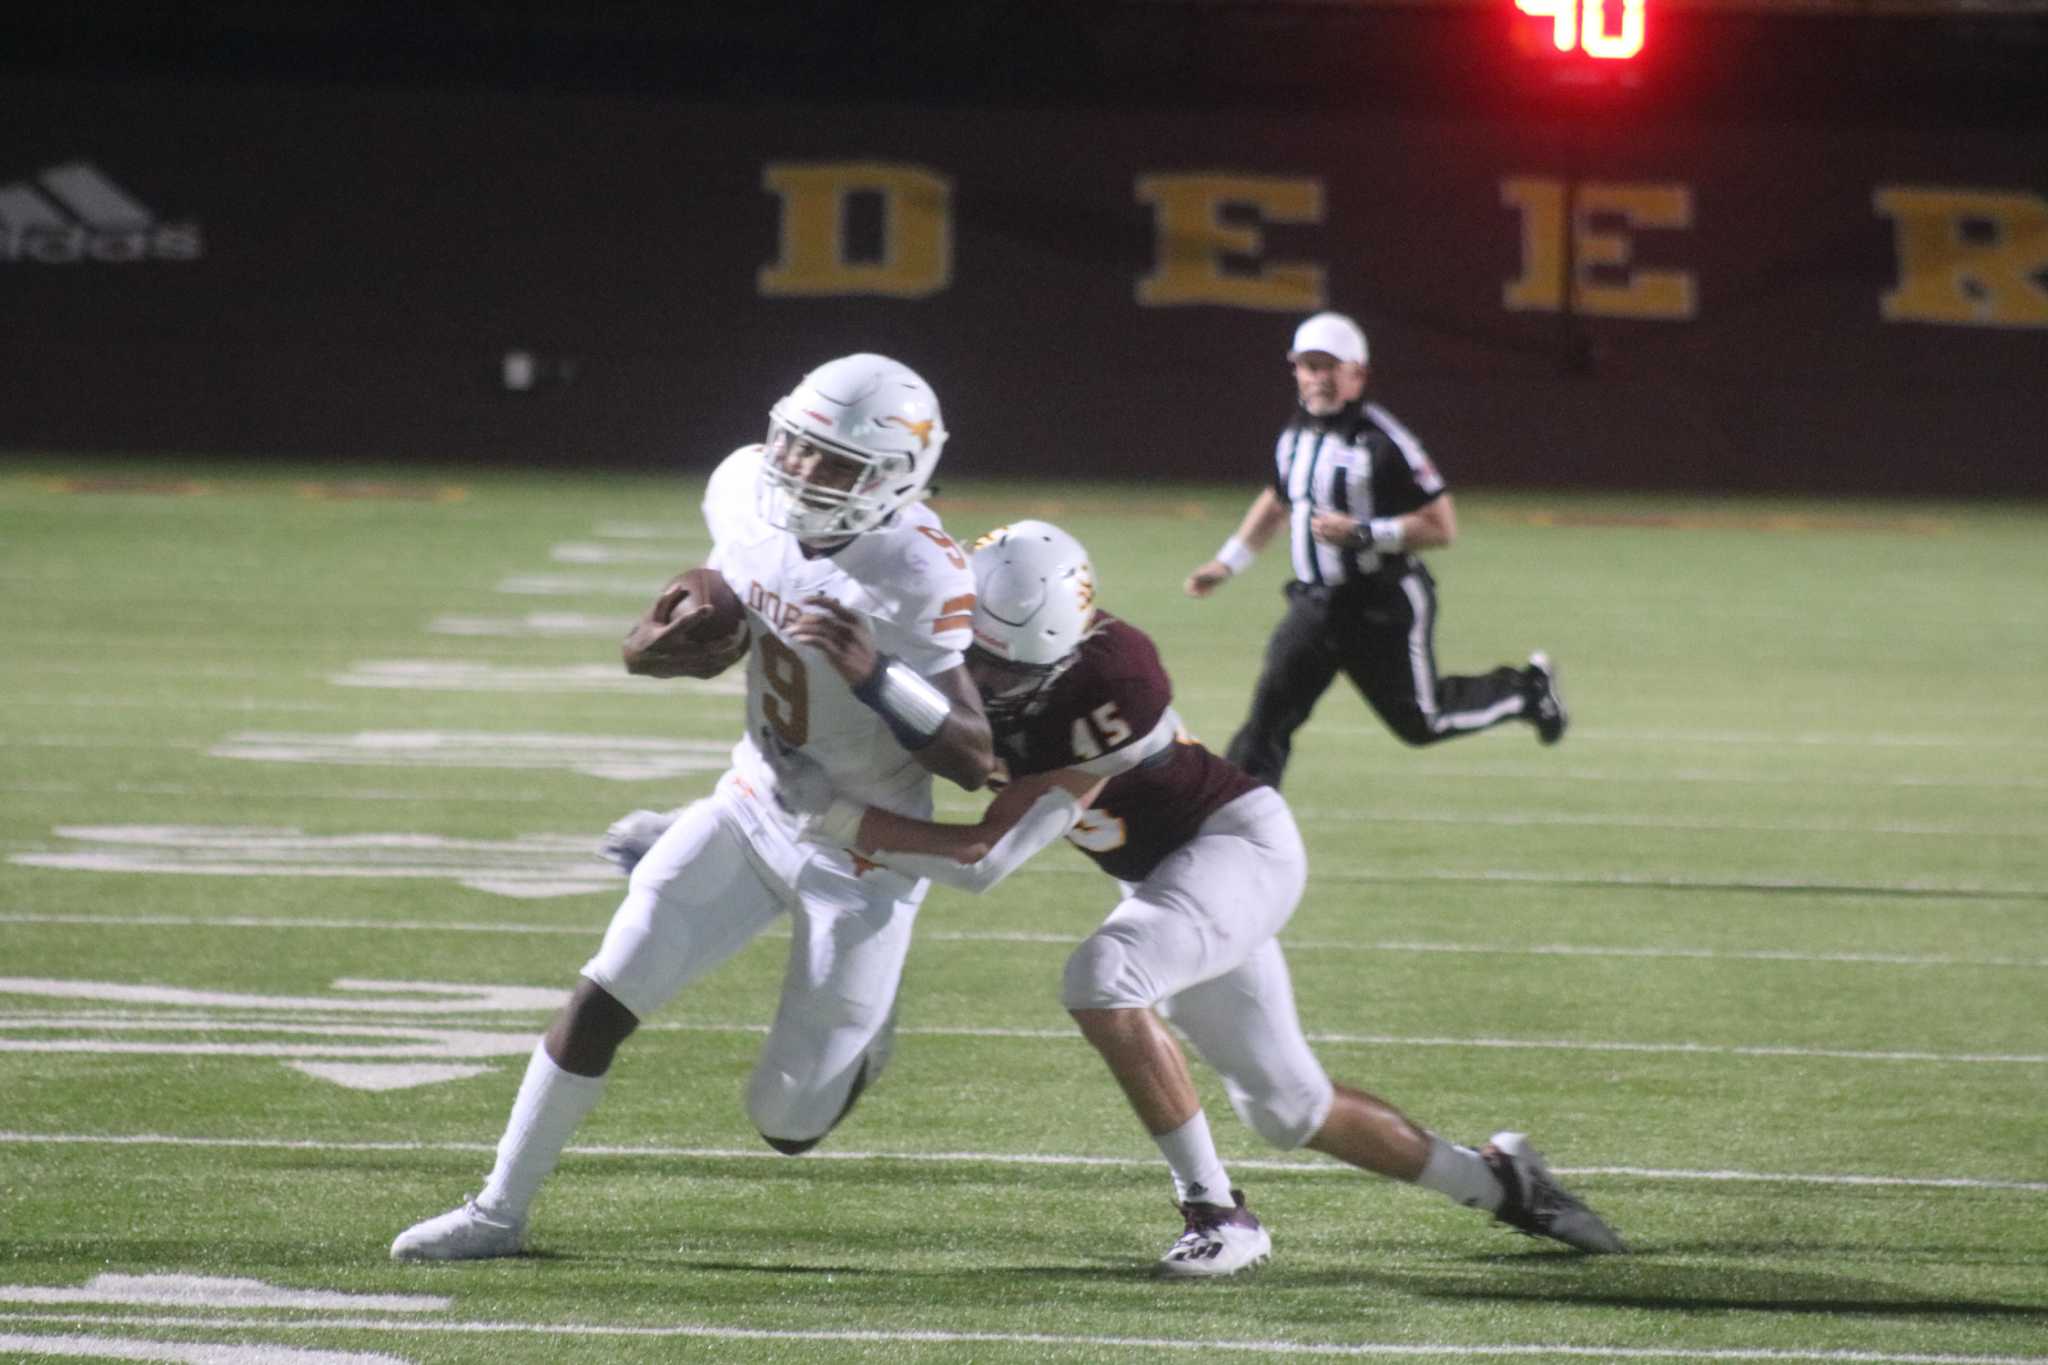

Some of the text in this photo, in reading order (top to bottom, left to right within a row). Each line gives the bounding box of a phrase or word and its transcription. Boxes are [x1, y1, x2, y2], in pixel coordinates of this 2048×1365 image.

[0, 219, 200, 263] idas
[758, 162, 2048, 328] DEER
[914, 525, 966, 570] 9
[759, 631, 807, 747] 9
[1070, 701, 1132, 759] 45
